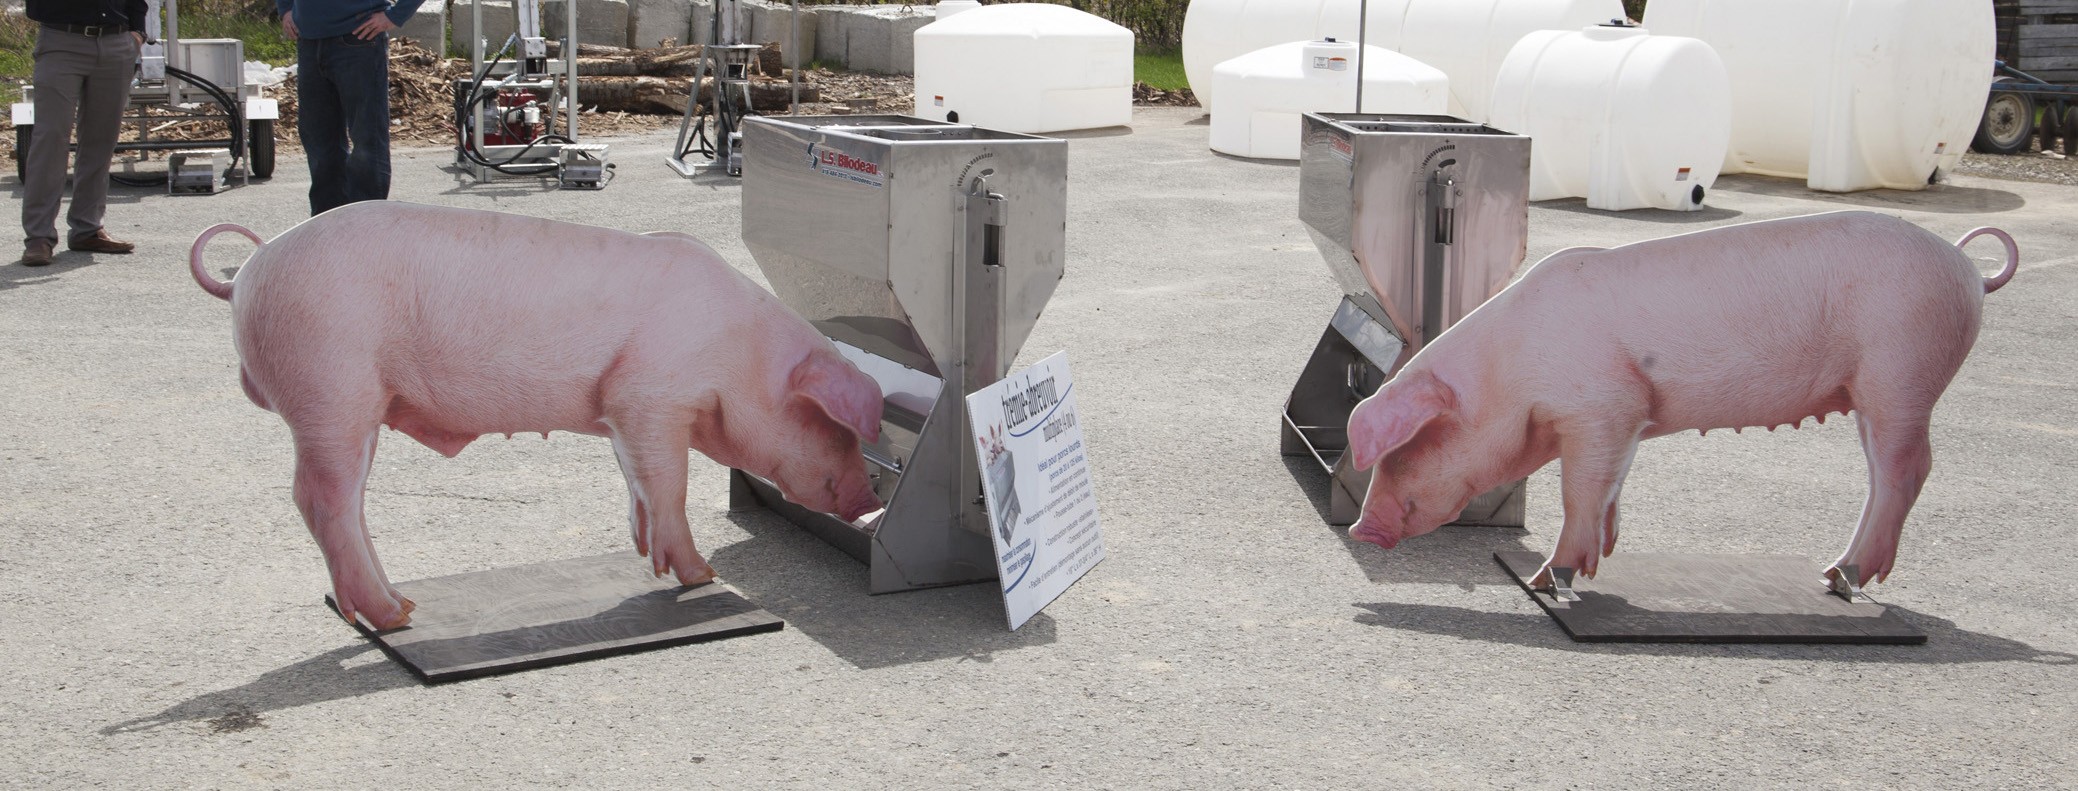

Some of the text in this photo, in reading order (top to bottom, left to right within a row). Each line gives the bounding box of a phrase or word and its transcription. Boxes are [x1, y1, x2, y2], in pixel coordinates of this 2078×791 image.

[838, 153, 877, 174] Bilodeau
[1001, 365, 1058, 430] trémie-abreuvoir
[1038, 439, 1080, 472] Idéal pour porcs lourds
[1047, 527, 1067, 546] Construction
[1069, 530, 1081, 544] Concept
